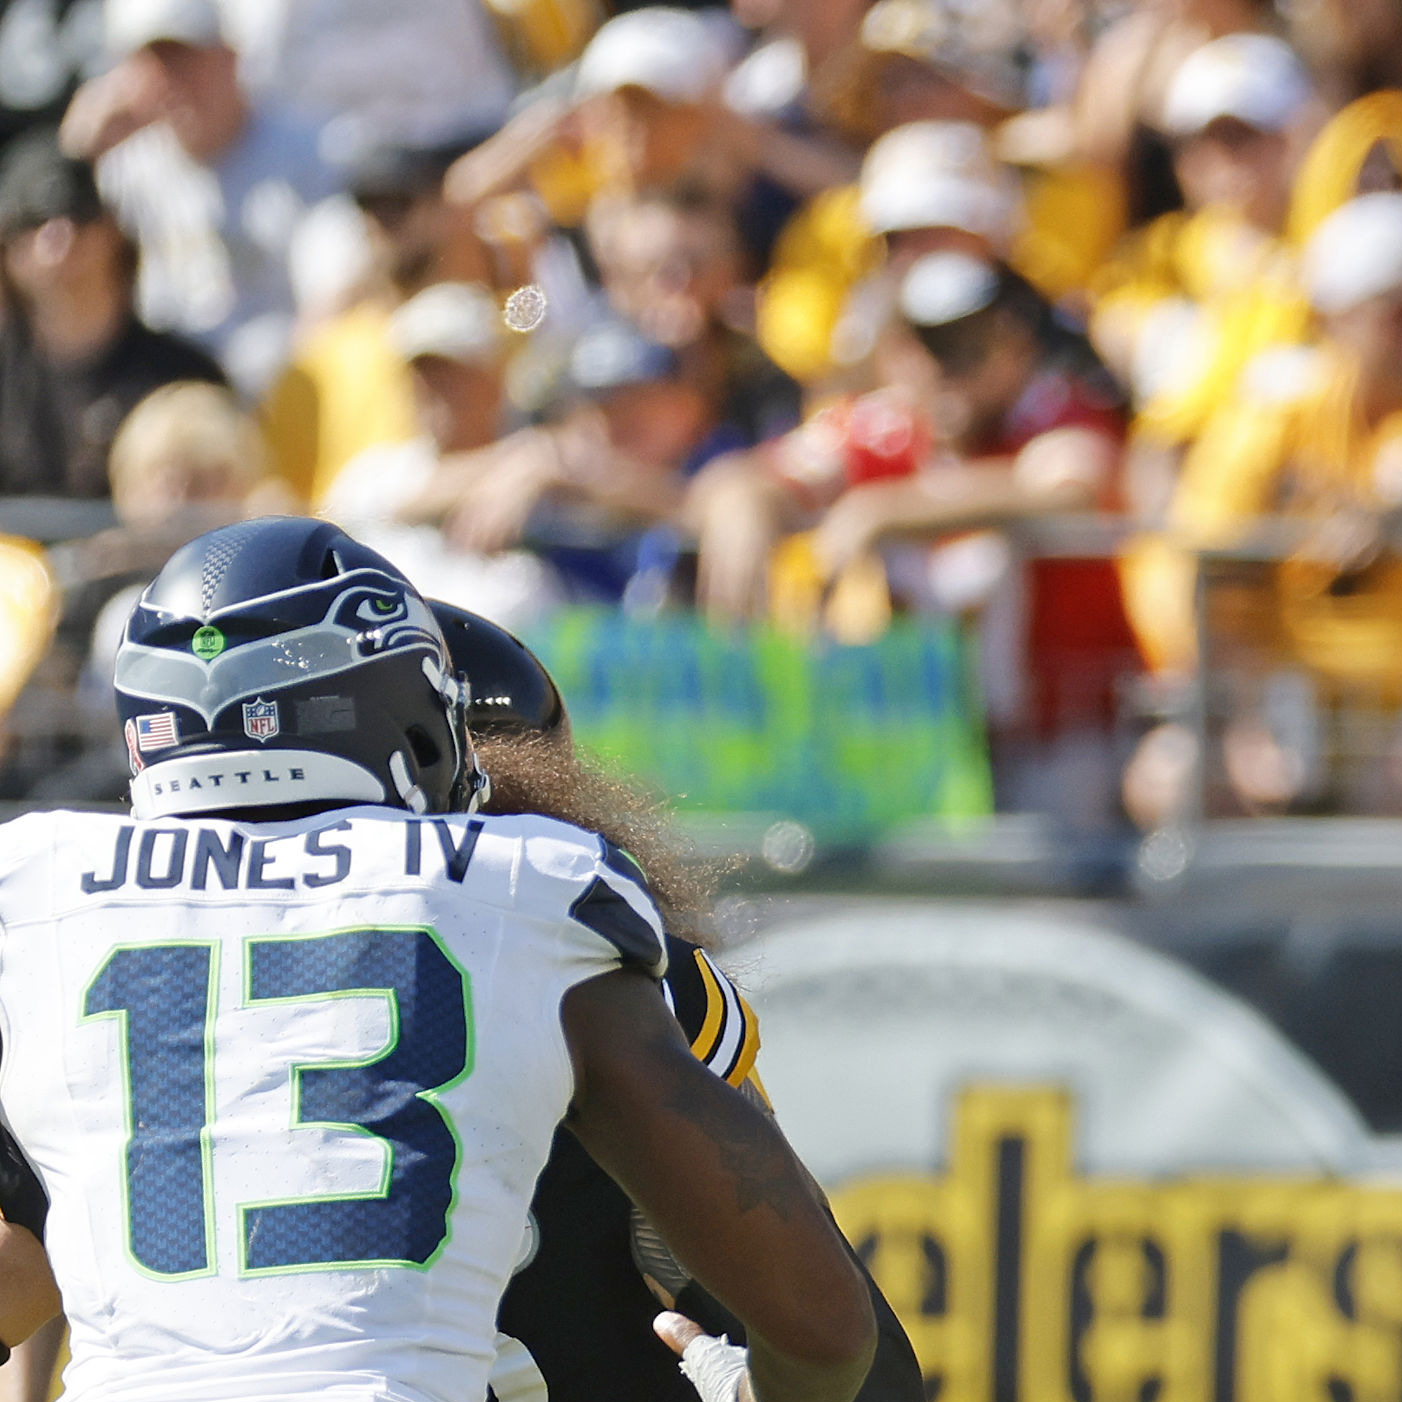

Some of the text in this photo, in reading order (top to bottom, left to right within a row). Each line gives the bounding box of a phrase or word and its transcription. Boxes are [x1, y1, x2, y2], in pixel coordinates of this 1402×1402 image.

[248, 717, 278, 735] NFL
[153, 767, 306, 796] SEATTLE
[80, 818, 486, 895] JONES IV
[76, 924, 476, 1281] 13
